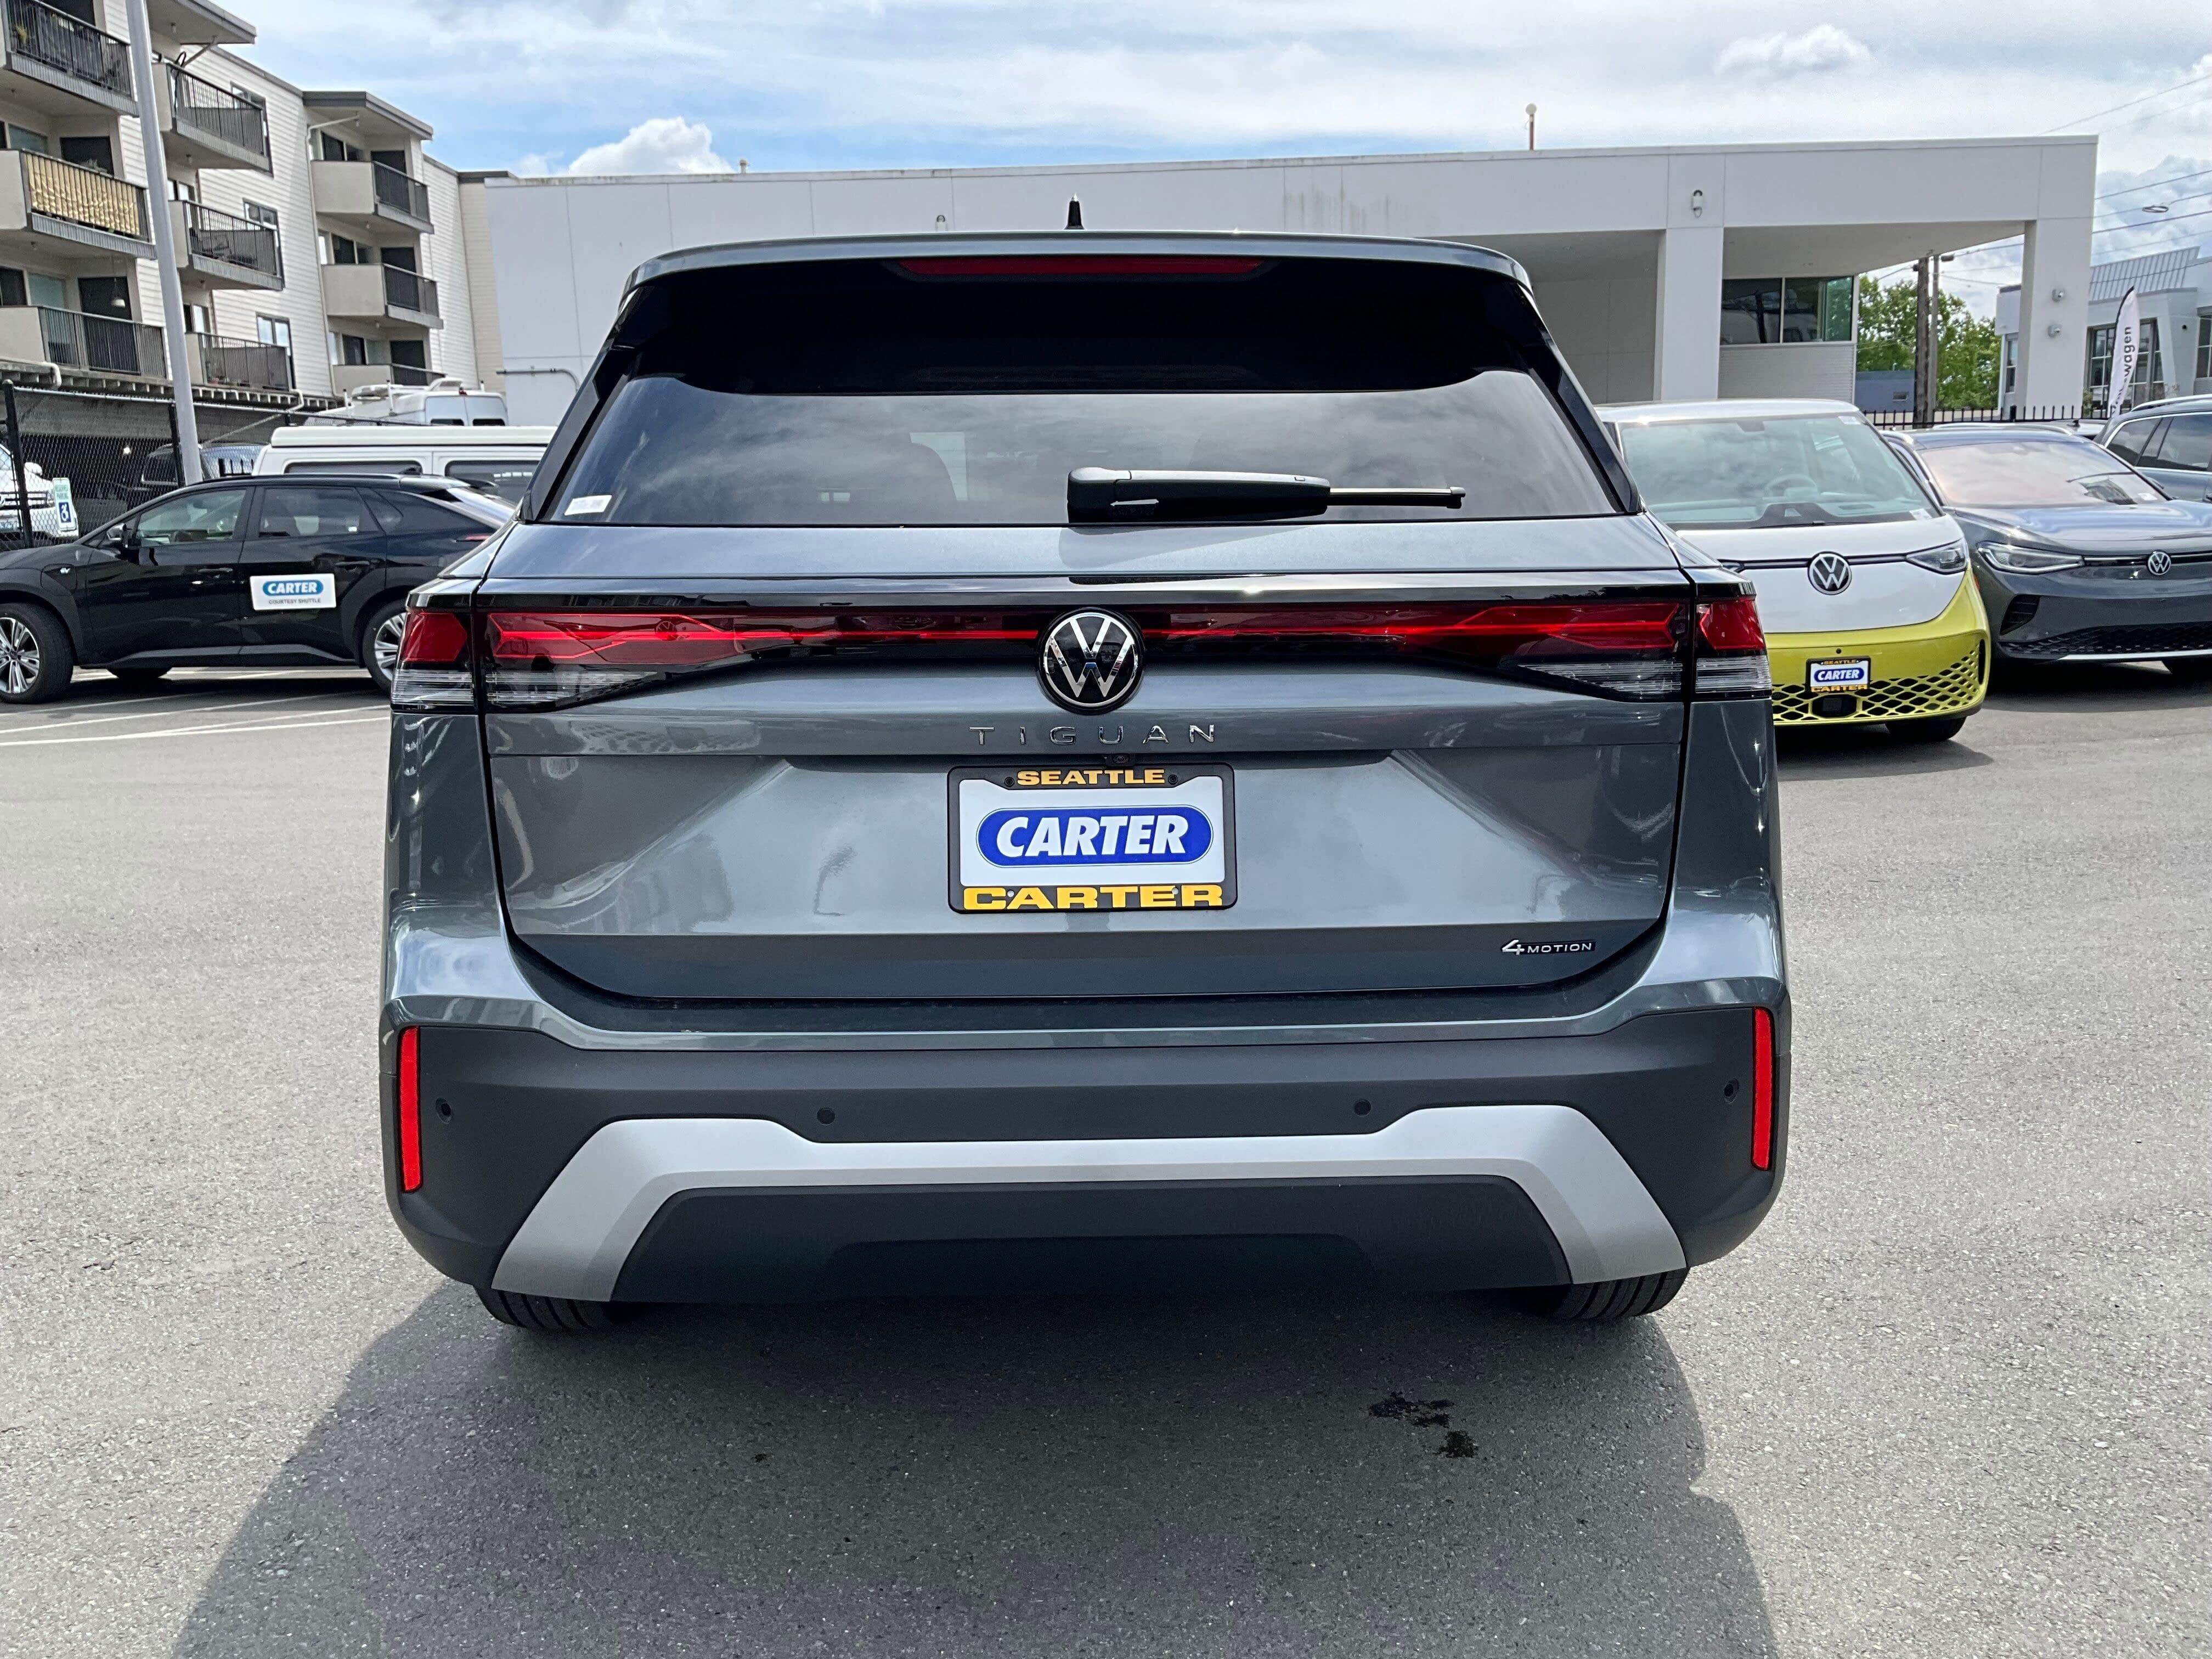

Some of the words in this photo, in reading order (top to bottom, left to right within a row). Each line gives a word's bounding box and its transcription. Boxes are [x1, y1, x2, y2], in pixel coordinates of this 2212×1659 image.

[1809, 554, 1852, 595] VW
[268, 582, 317, 594] CARTER
[1044, 612, 1138, 707] VW
[1818, 669, 1860, 681] CARTER
[969, 724, 1215, 746] TIGUAN
[1017, 769, 1165, 786] SEATTLE
[996, 815, 1189, 857] CARTER
[963, 884, 1223, 910] CARTER
[1502, 939, 1592, 955] 4MOTION
